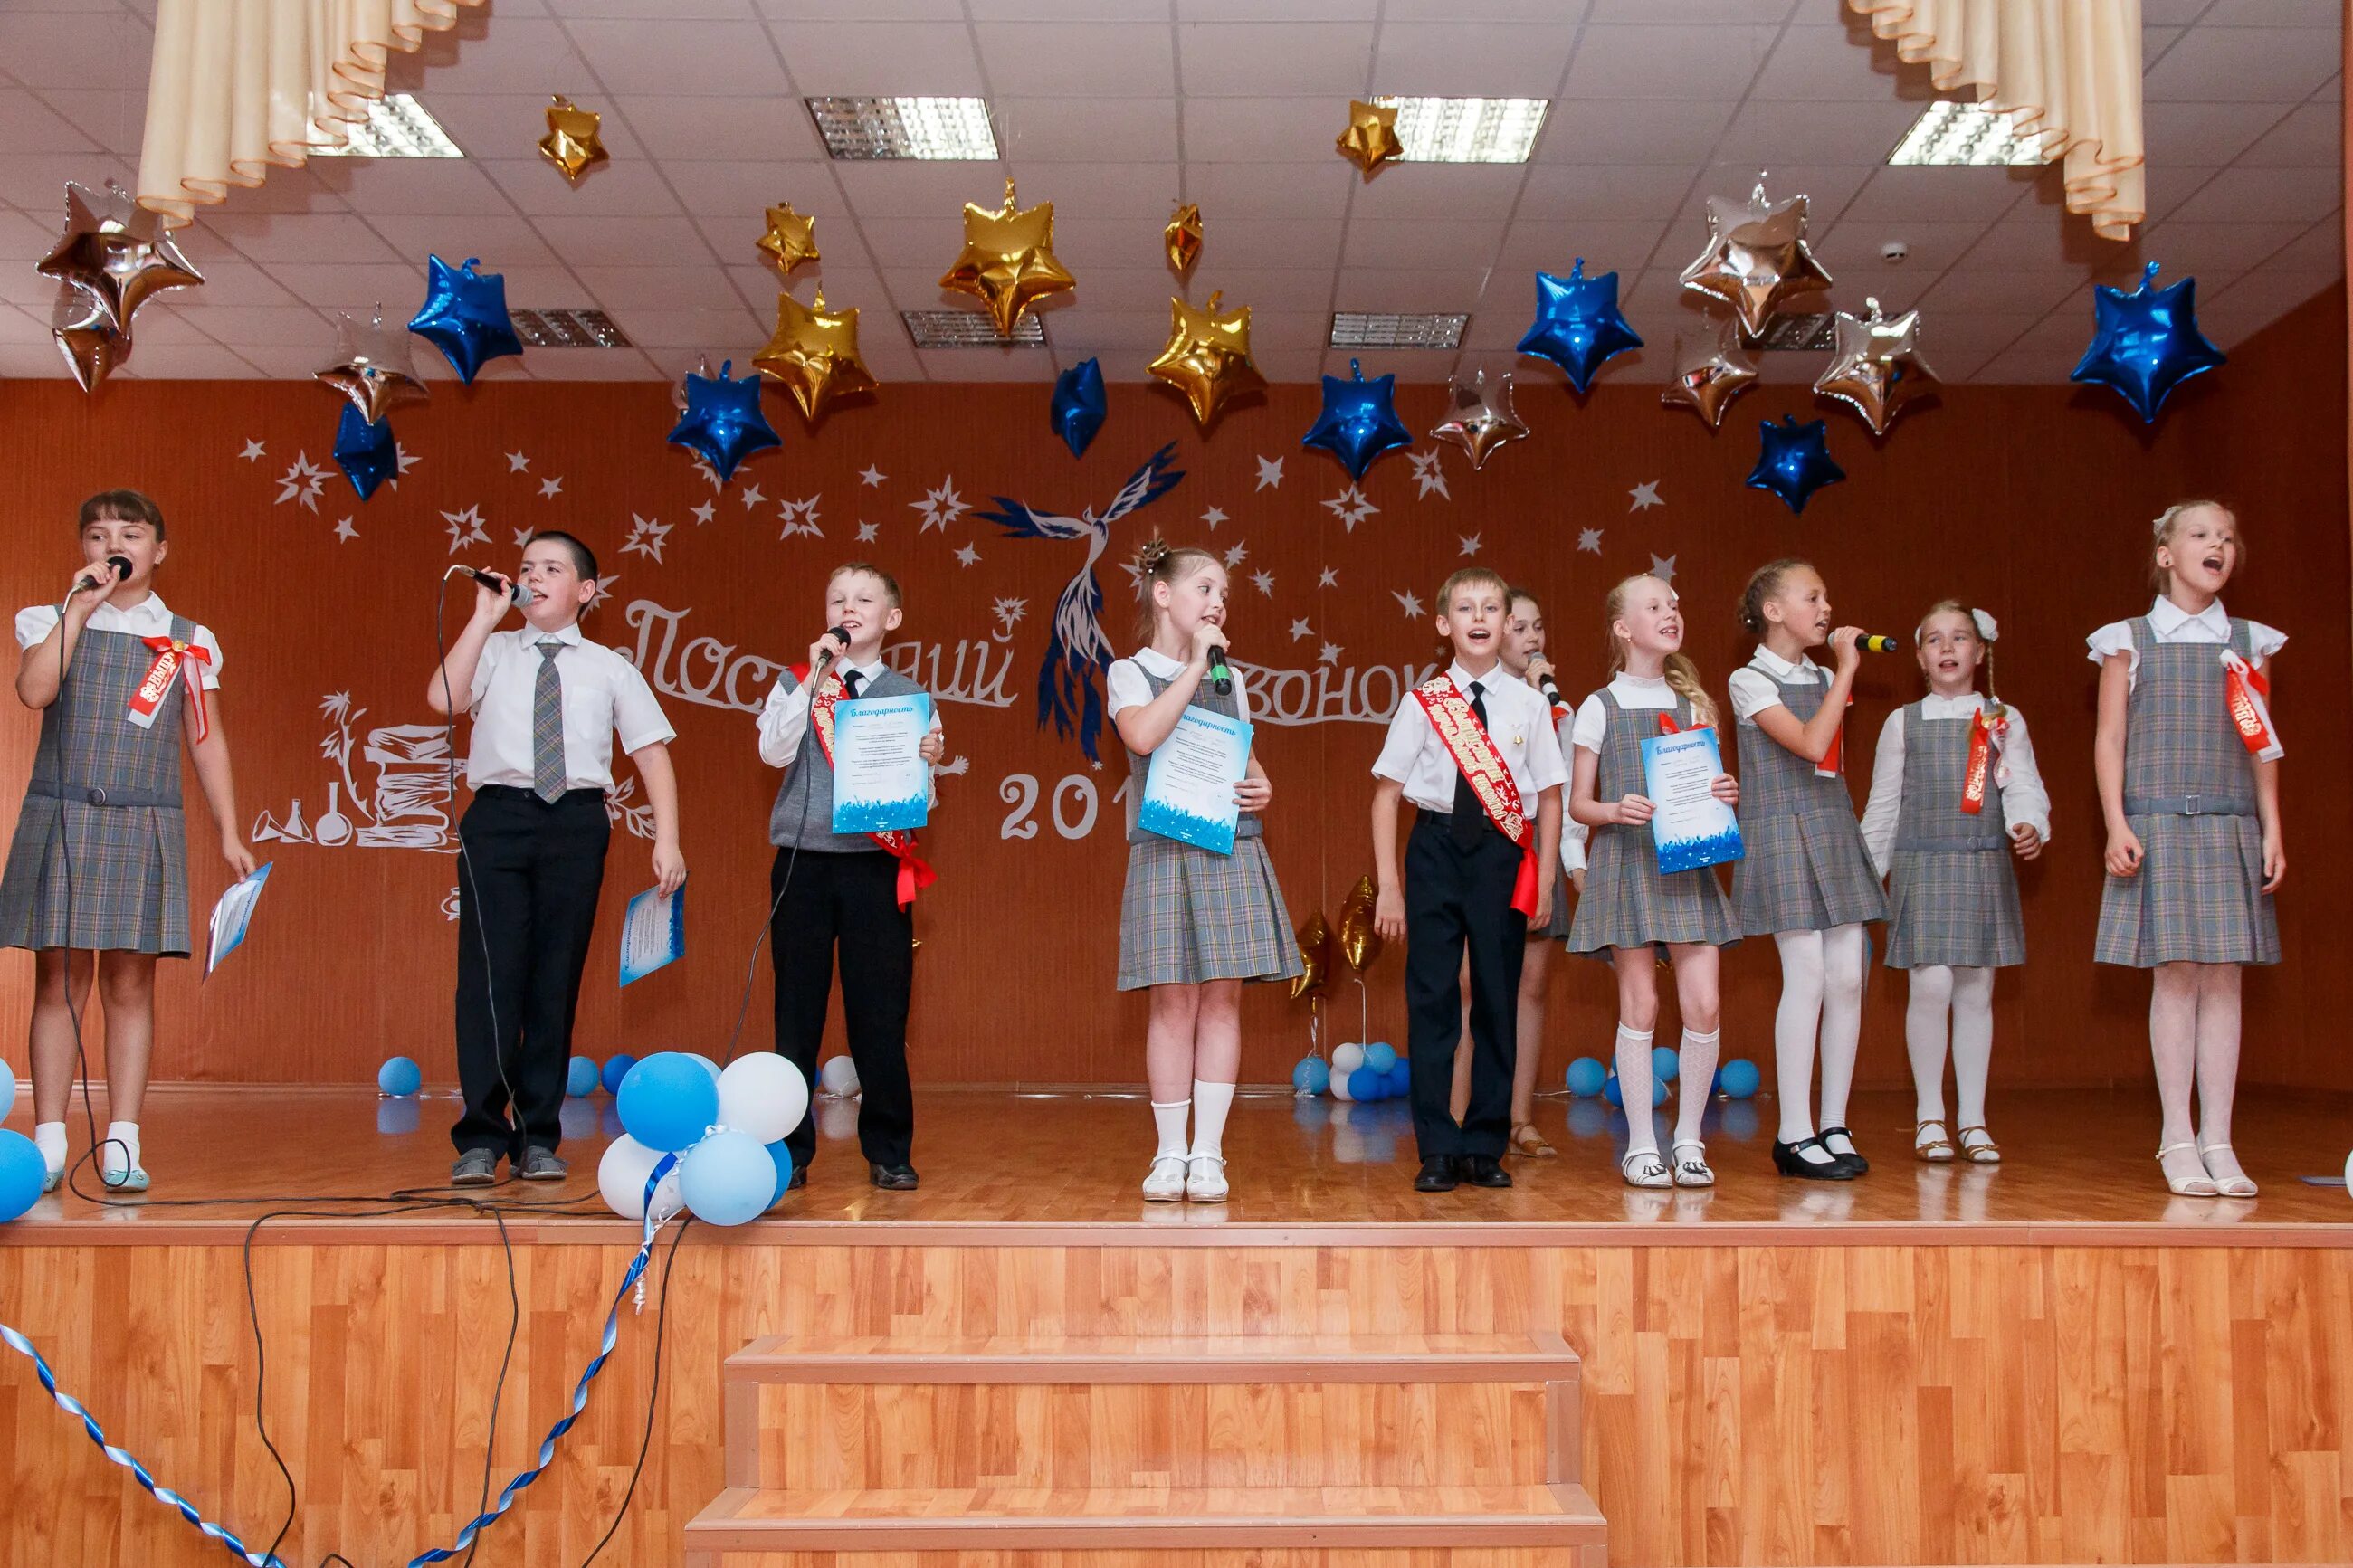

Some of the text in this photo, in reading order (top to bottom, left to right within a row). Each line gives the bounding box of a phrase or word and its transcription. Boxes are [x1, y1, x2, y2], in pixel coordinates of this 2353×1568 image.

[615, 599, 1019, 715] Посний
[851, 706, 913, 717] Благодарность
[1183, 714, 1236, 736] лагодарность
[1655, 740, 1706, 755] Благодарность
[1000, 774, 1132, 841] 201
